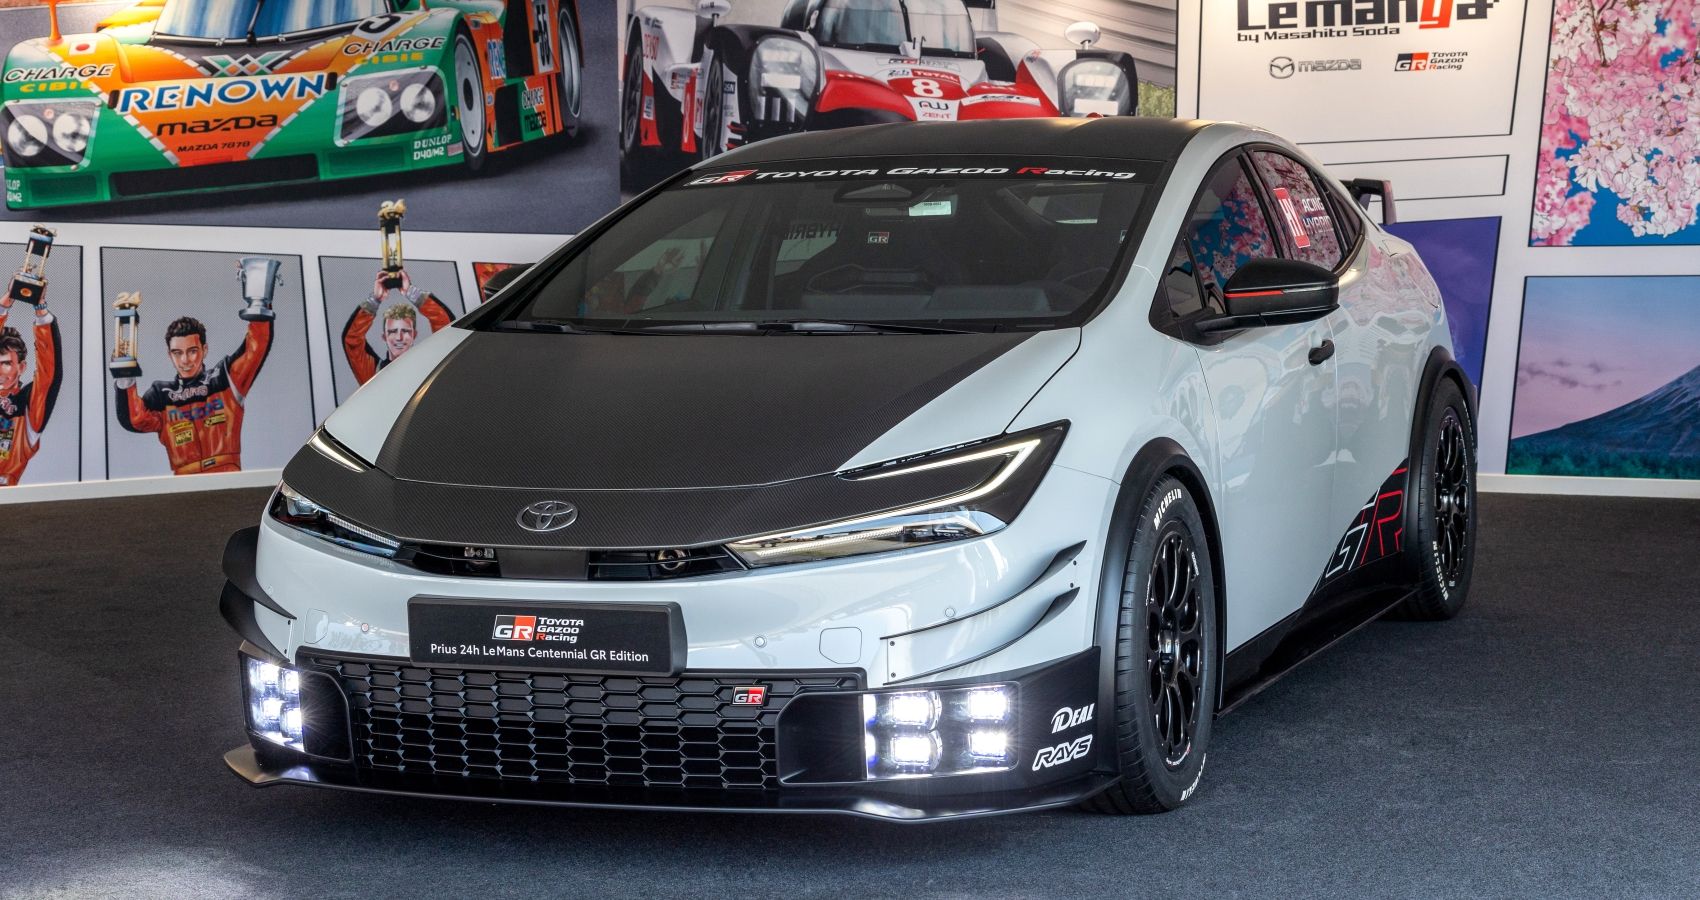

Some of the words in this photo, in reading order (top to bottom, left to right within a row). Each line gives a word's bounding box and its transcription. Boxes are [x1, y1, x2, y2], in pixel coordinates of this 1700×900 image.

[1237, 33, 1259, 43] by
[1264, 28, 1347, 41] Masahito
[1352, 26, 1400, 36] Soda
[342, 37, 446, 55] CHARGE
[4, 65, 117, 82] CHARGE
[913, 70, 959, 83] TOTAL
[118, 73, 326, 113] RENOWN
[912, 78, 944, 98] 8
[156, 114, 278, 137] mazda
[177, 143, 218, 153] MAZDA
[413, 134, 452, 149] DUNLOP
[690, 174, 745, 186] GR
[755, 170, 879, 180] TOYOTA
[887, 167, 1010, 175] GAZOO
[1016, 167, 1137, 180] Racing
[1153, 488, 1183, 531] MICHELIN
[537, 625, 579, 634] GAZOO
[538, 617, 584, 626] TOYOTA
[535, 633, 578, 644] Racing
[430, 643, 457, 655] Prius
[460, 644, 480, 656] 24h
[527, 647, 588, 660] Centennial
[590, 649, 607, 661] GR
[609, 650, 649, 662] Edition
[1031, 733, 1093, 772] RAYS
